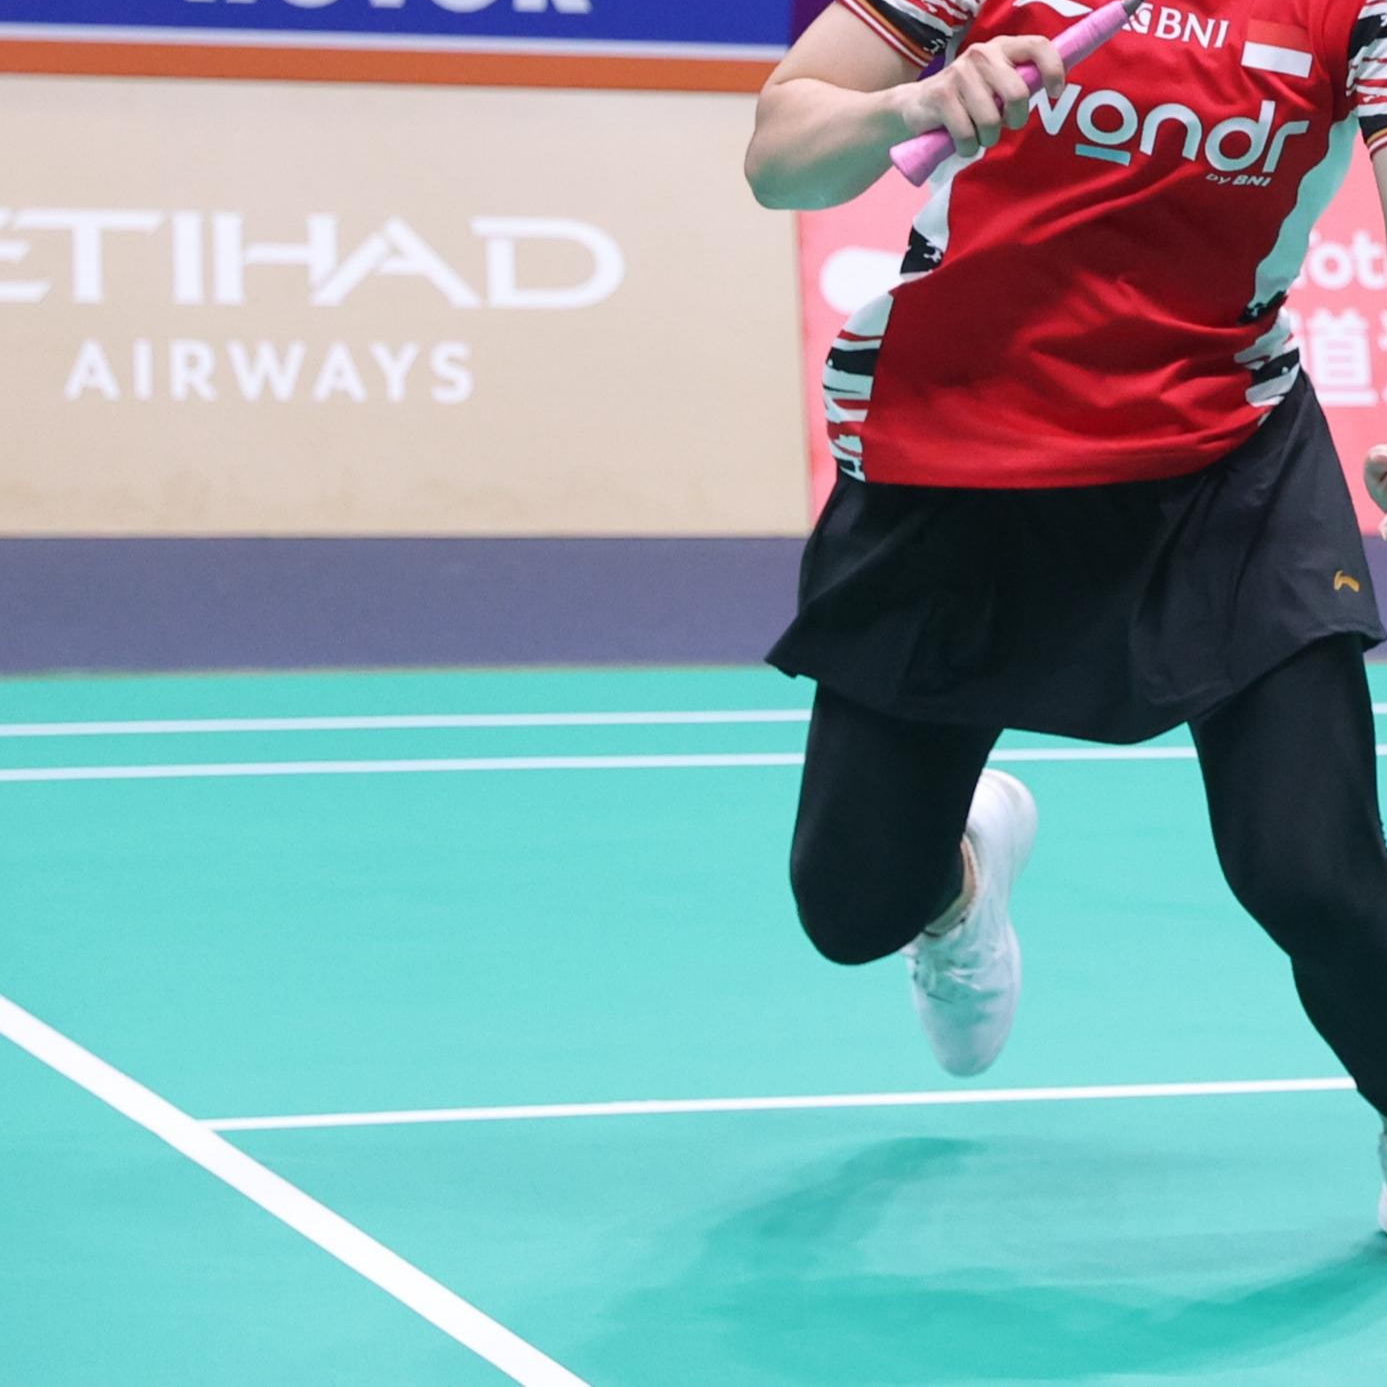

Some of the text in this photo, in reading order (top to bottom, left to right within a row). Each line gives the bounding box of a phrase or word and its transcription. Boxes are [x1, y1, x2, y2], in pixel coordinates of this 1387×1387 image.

[1154, 6, 1230, 49] BNI
[1205, 173, 1271, 187] by BNI
[64, 338, 475, 405] AIRWAYS
